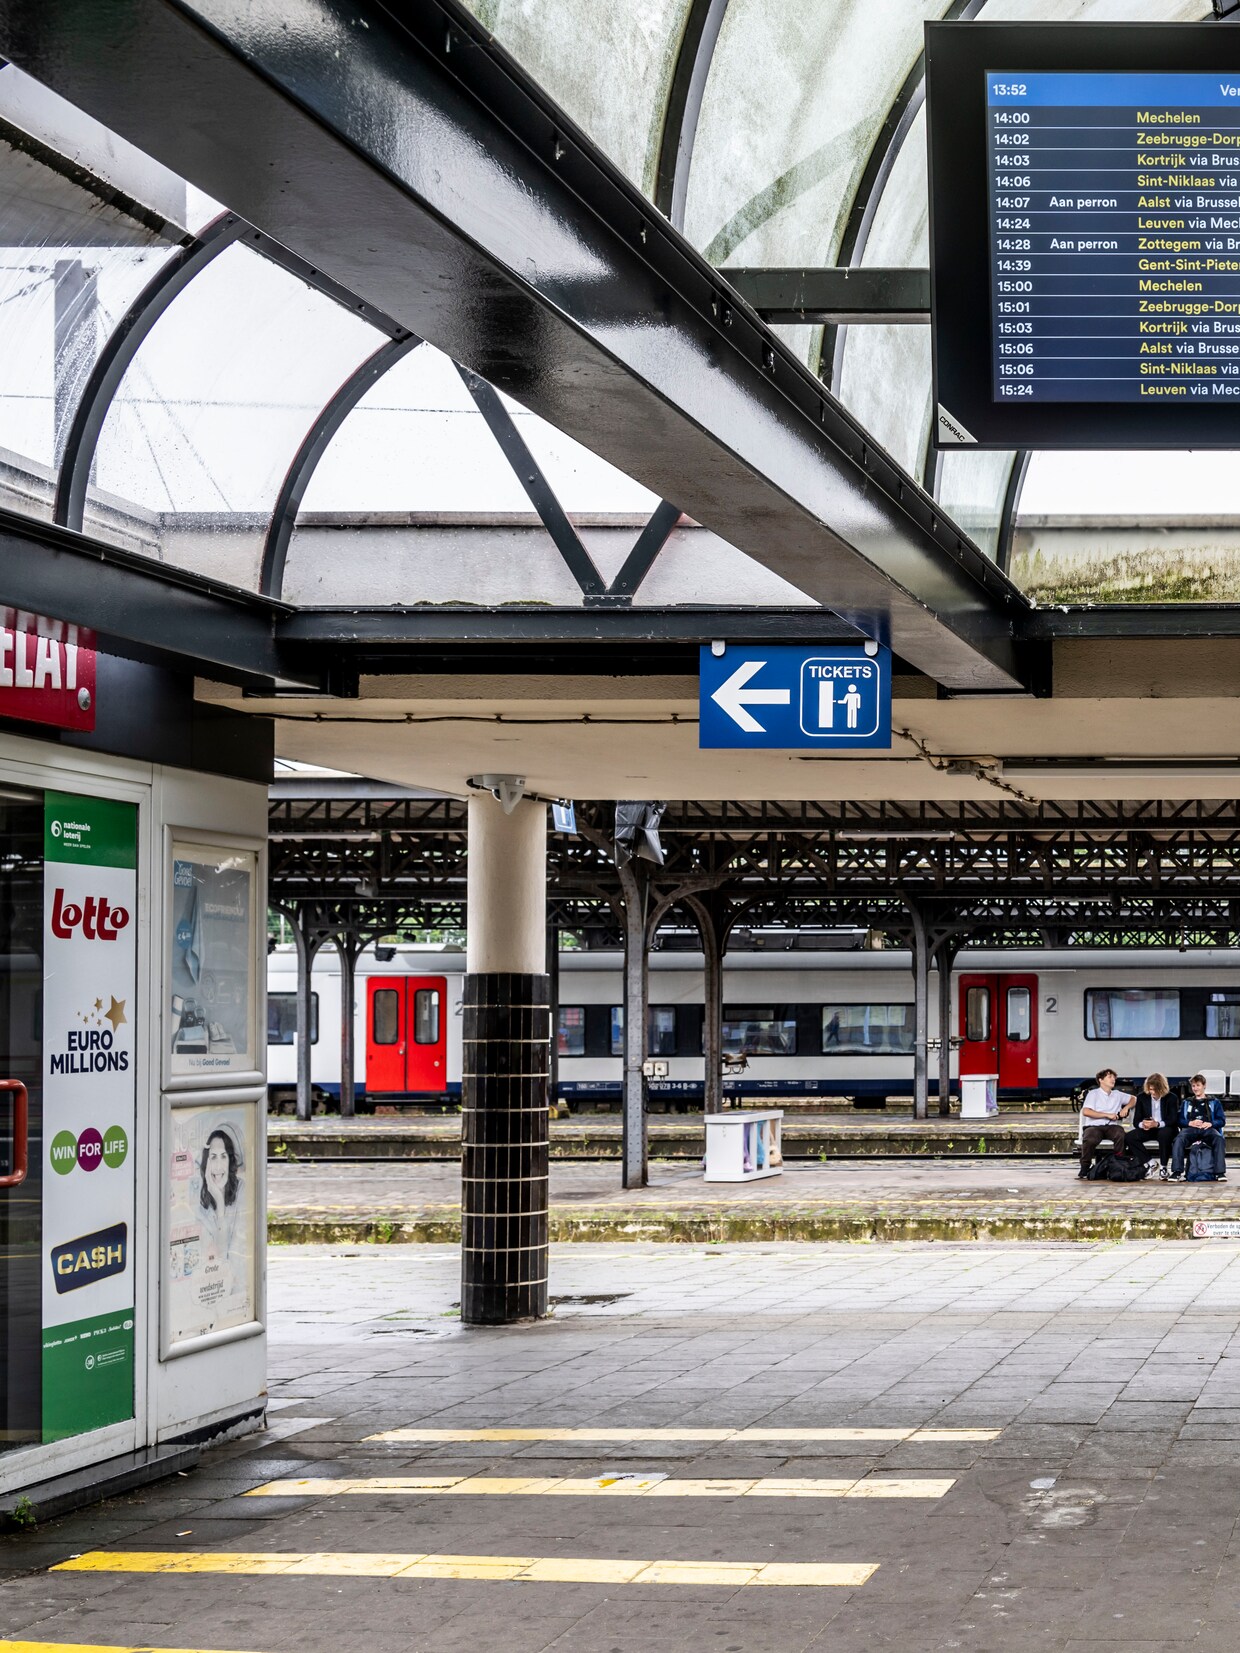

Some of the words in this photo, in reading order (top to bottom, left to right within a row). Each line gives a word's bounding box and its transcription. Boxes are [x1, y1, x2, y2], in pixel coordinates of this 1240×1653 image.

[993, 84, 1027, 96] 13:52
[994, 113, 1029, 123] 14:00
[1137, 112, 1200, 123] Mechelen
[995, 134, 1029, 144] 14:02
[995, 155, 1029, 165] 14:03
[1138, 154, 1185, 168] Kortrijk
[1190, 154, 1207, 165] via
[996, 176, 1030, 186] 14:06
[1138, 175, 1215, 186] Sint-Niklaas
[1219, 175, 1237, 186] via
[996, 198, 1030, 207] 14:07
[1050, 197, 1073, 207] Aan
[1076, 198, 1118, 209] perron
[1138, 196, 1170, 207] Aalst
[1175, 196, 1192, 207] via
[1197, 196, 1240, 207] Brussel
[997, 219, 1030, 228] 14:24
[1139, 217, 1184, 228] Leuven
[1189, 217, 1206, 228] via
[997, 239, 1030, 249] 14:28
[1050, 239, 1074, 249] Aan
[1077, 240, 1118, 251] perron
[1139, 238, 1200, 252] Zottegem
[1205, 238, 1223, 249] via
[998, 260, 1031, 270] 14:39
[998, 281, 1032, 291] 15:00
[1140, 280, 1202, 291] Mechelen
[998, 302, 1029, 312] 15:01
[999, 323, 1032, 333] 15:03
[1140, 322, 1187, 335] Kortrijk
[1192, 322, 1209, 332] via
[999, 344, 1033, 354] 15:06
[1140, 342, 1172, 353] Aalst
[1176, 342, 1194, 353] via
[1000, 364, 1033, 374] 15:06
[1141, 363, 1217, 374] Sint-Niklaas
[1221, 363, 1239, 374] via
[1000, 384, 1033, 395] 15:24
[1141, 384, 1186, 394] Leuven
[1190, 384, 1208, 394] via
[939, 416, 965, 441] CONRAC
[809, 666, 872, 678] TICKETS
[64, 822, 90, 831] nationale
[64, 831, 81, 841] loterij
[1046, 997, 1057, 1013] 2
[68, 1030, 113, 1052] EURO
[50, 1051, 128, 1075] MILLIONS
[53, 1146, 75, 1160] WIN
[79, 1143, 101, 1157] FOR
[105, 1140, 125, 1154] LIFE
[200, 1280, 224, 1294] wedstrijd
